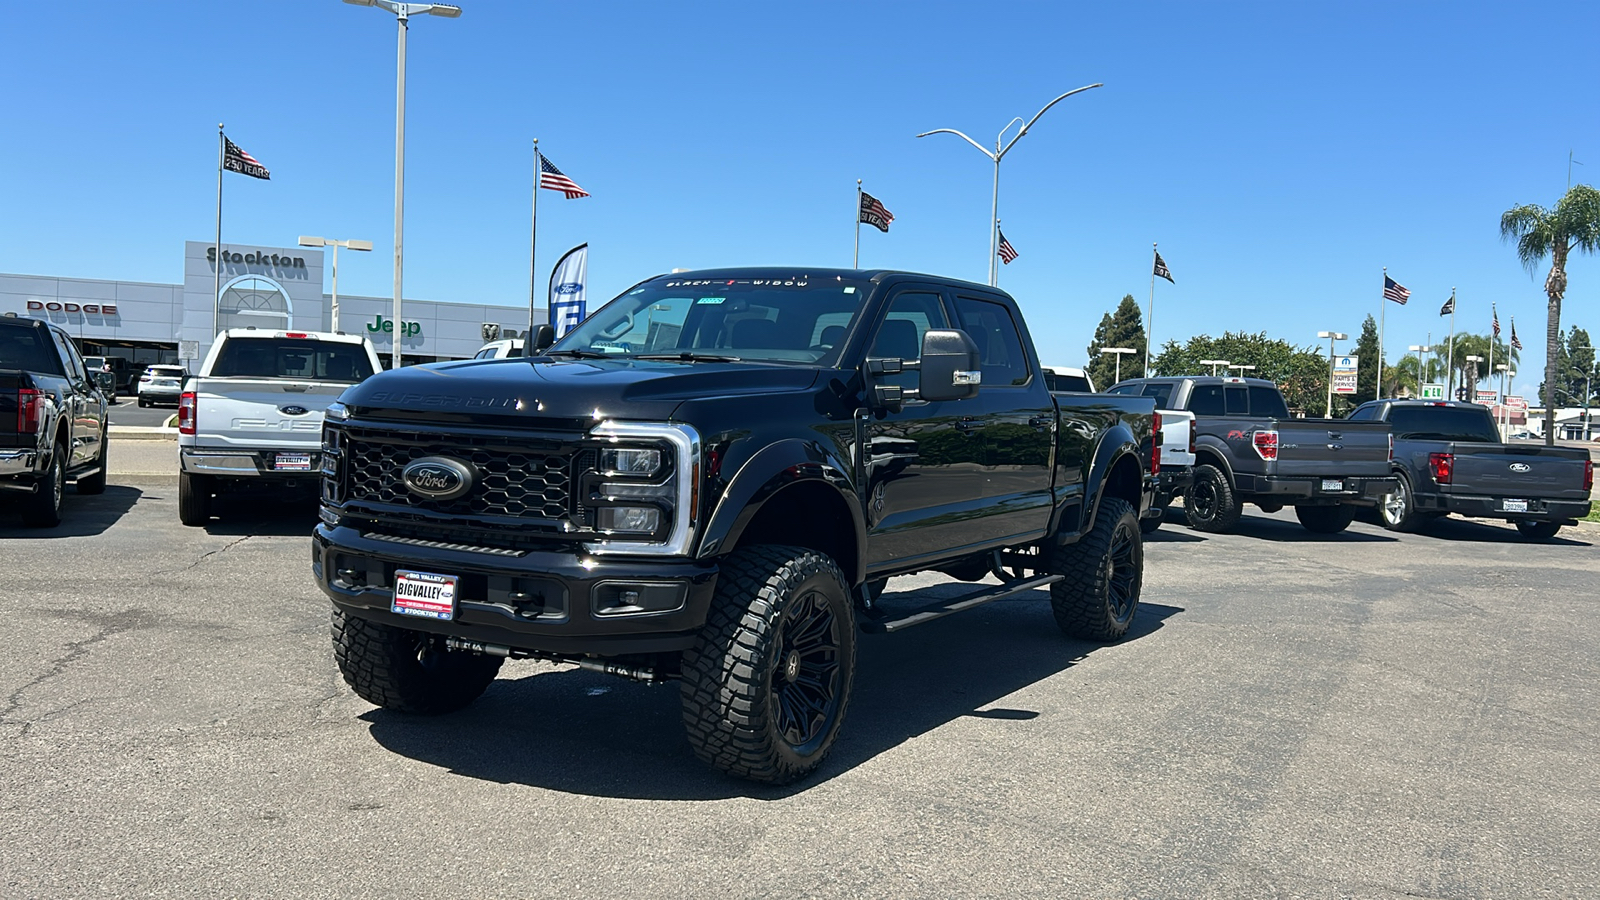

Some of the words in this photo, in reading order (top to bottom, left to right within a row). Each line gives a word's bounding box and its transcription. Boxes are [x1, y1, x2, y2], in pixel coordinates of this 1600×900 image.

[226, 158, 243, 171] 250
[243, 163, 270, 178] YEARS
[206, 246, 306, 268] Stockton
[27, 300, 118, 315] DODGE
[370, 391, 462, 407] SUPER
[231, 417, 322, 432] F-15
[1227, 430, 1252, 439] FX4
[415, 468, 449, 488] Ford
[397, 582, 442, 600] BIGVALLEY
[404, 608, 439, 618] STOCKTON
